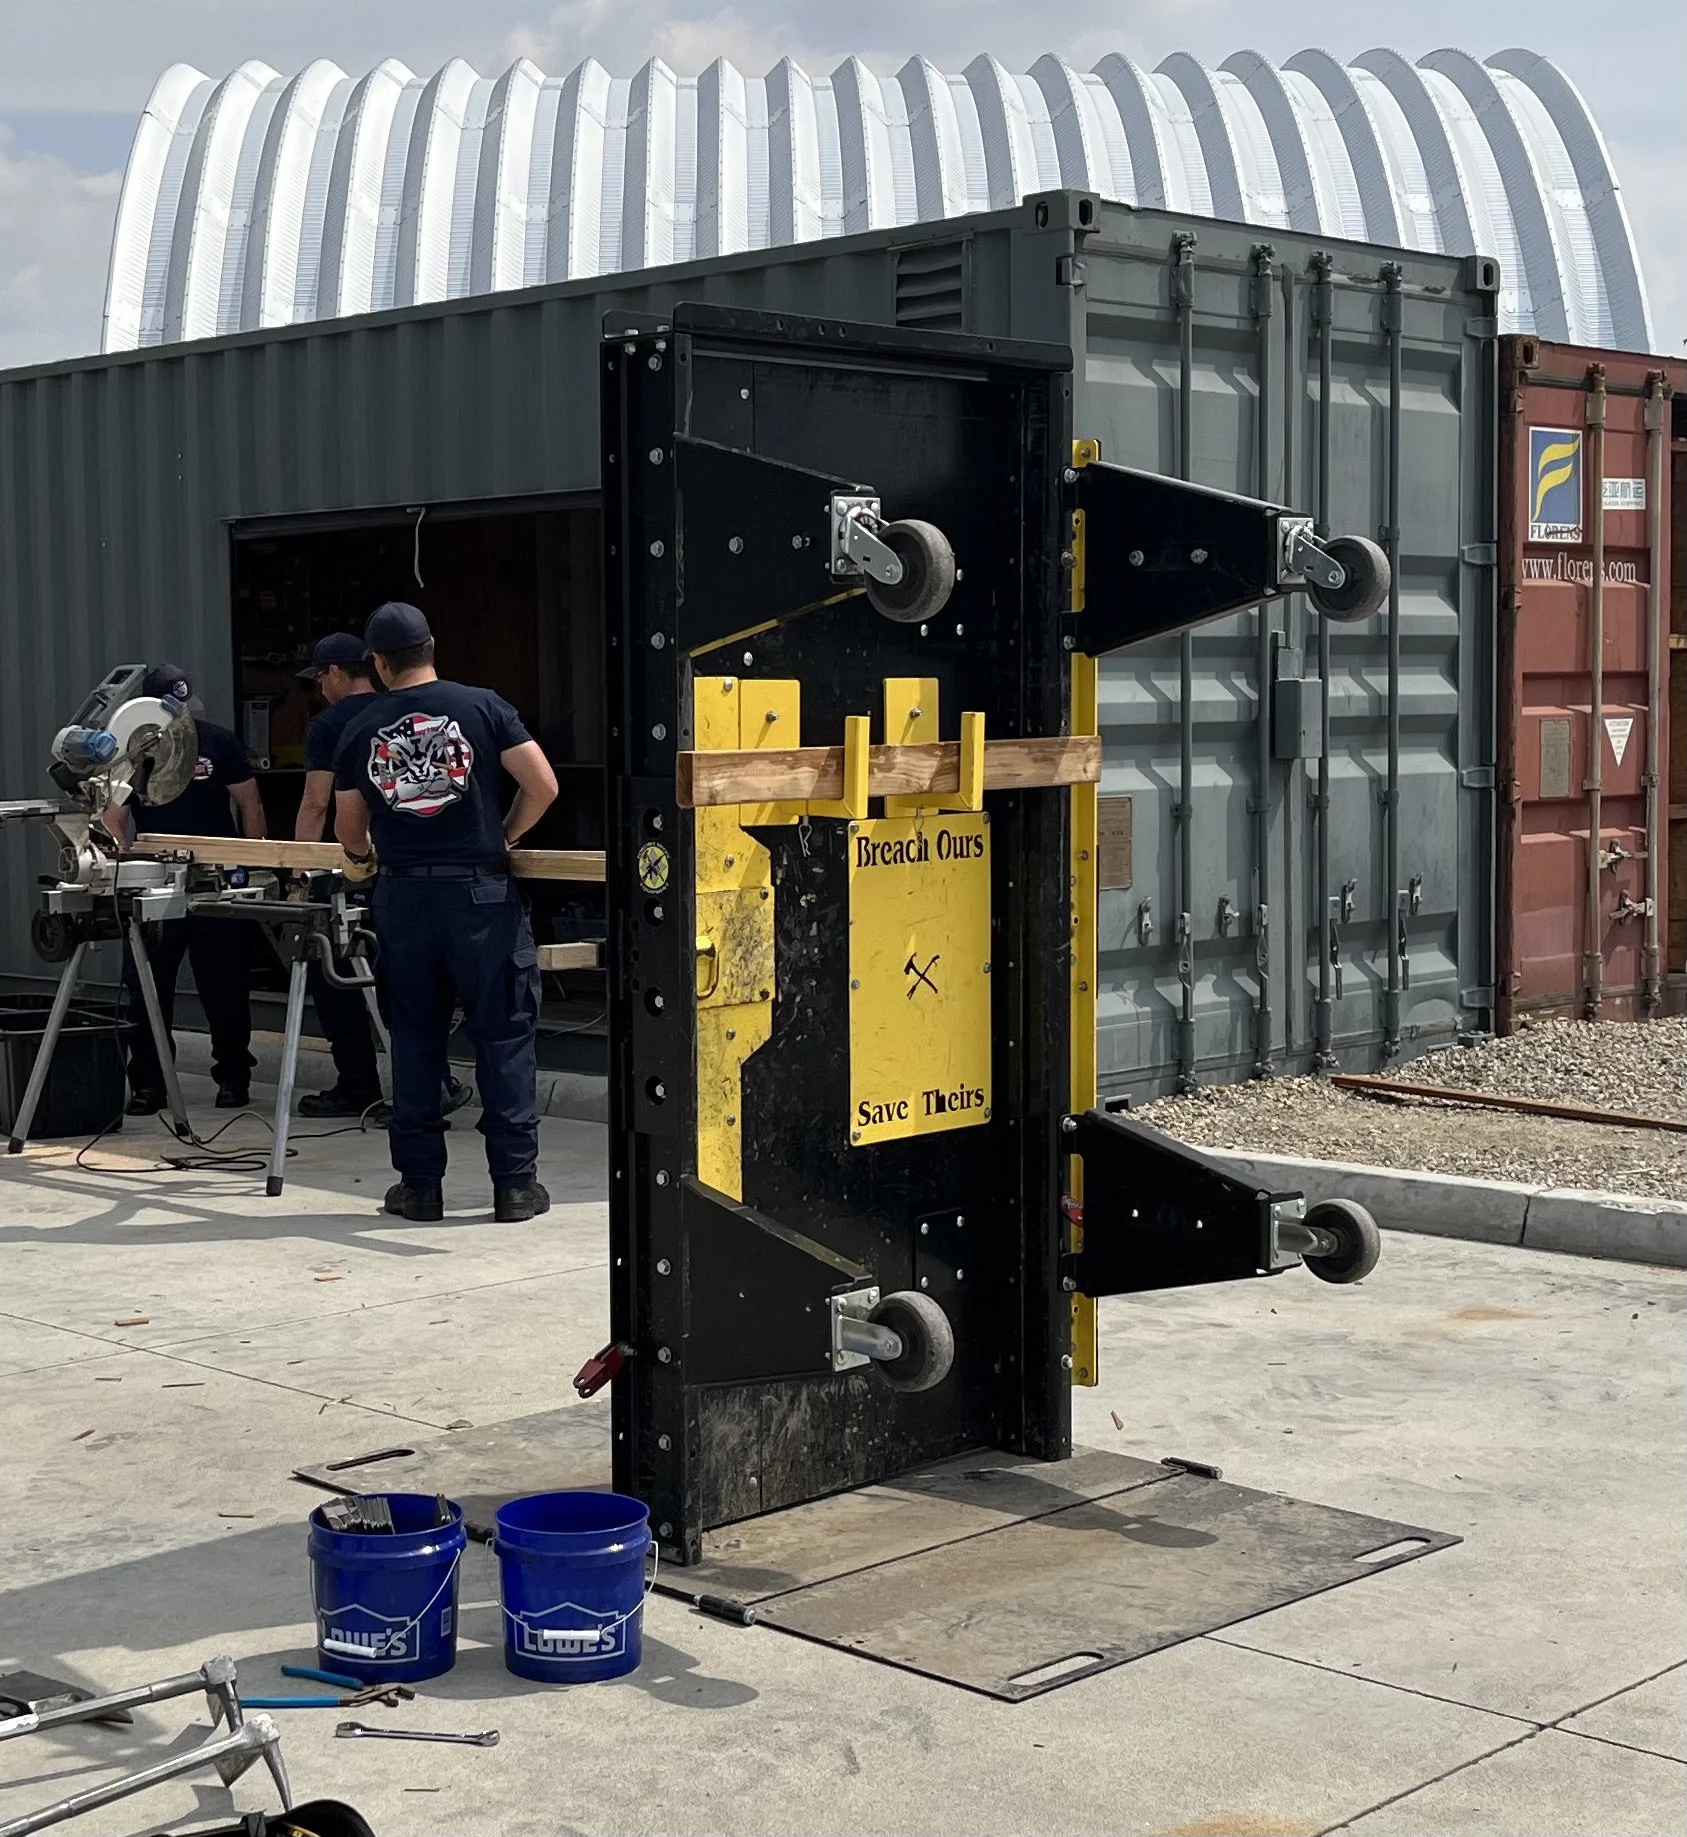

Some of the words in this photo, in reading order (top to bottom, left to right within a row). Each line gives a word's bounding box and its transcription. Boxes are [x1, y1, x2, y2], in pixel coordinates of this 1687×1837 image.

[1530, 524, 1581, 540] FLORENS
[856, 831, 929, 867] Breach
[937, 829, 984, 860] Ours
[857, 1100, 908, 1127] Save
[922, 1083, 985, 1116] Theirs
